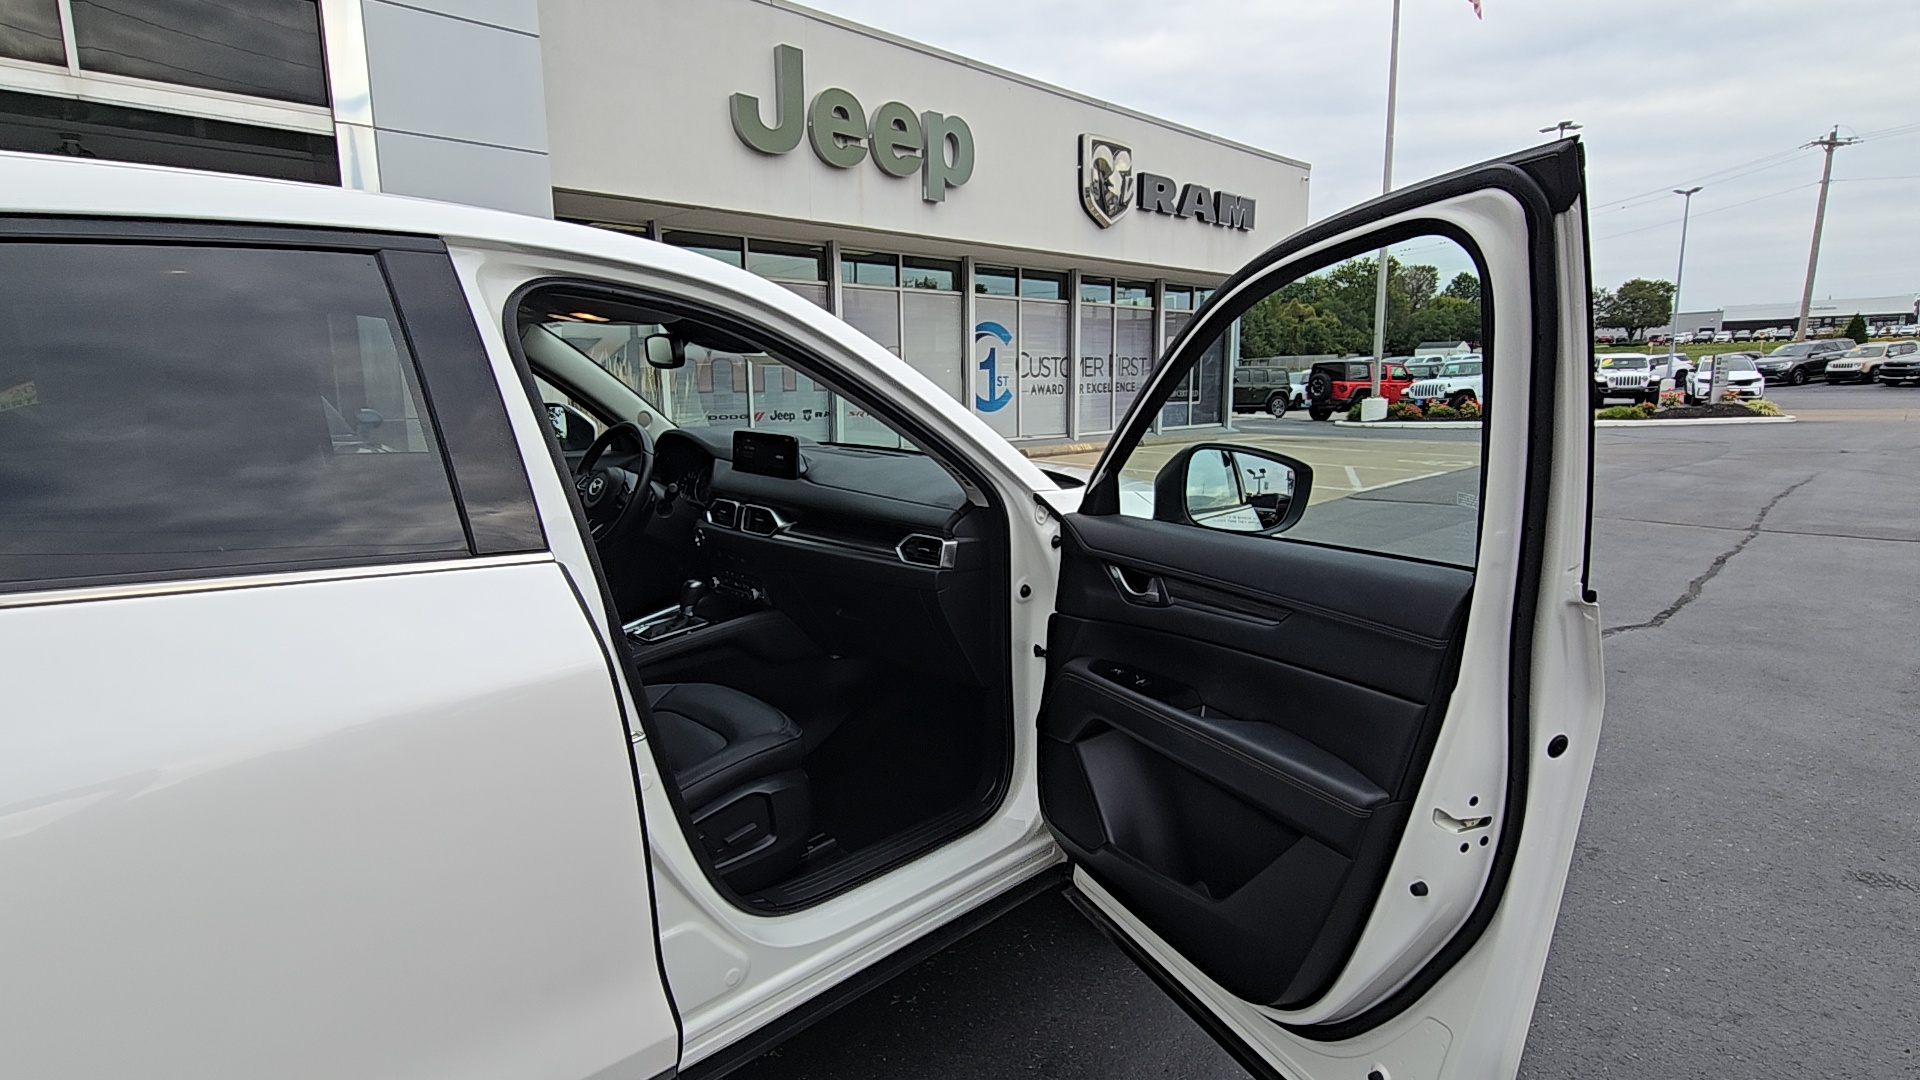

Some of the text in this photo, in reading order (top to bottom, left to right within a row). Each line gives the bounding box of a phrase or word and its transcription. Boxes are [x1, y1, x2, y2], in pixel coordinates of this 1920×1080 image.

[729, 43, 975, 202] Jeep
[1137, 171, 1257, 231] RAM
[1030, 383, 1065, 395] AWARD
[1086, 381, 1136, 394] EXCELENCE
[770, 410, 796, 422] Jeep
